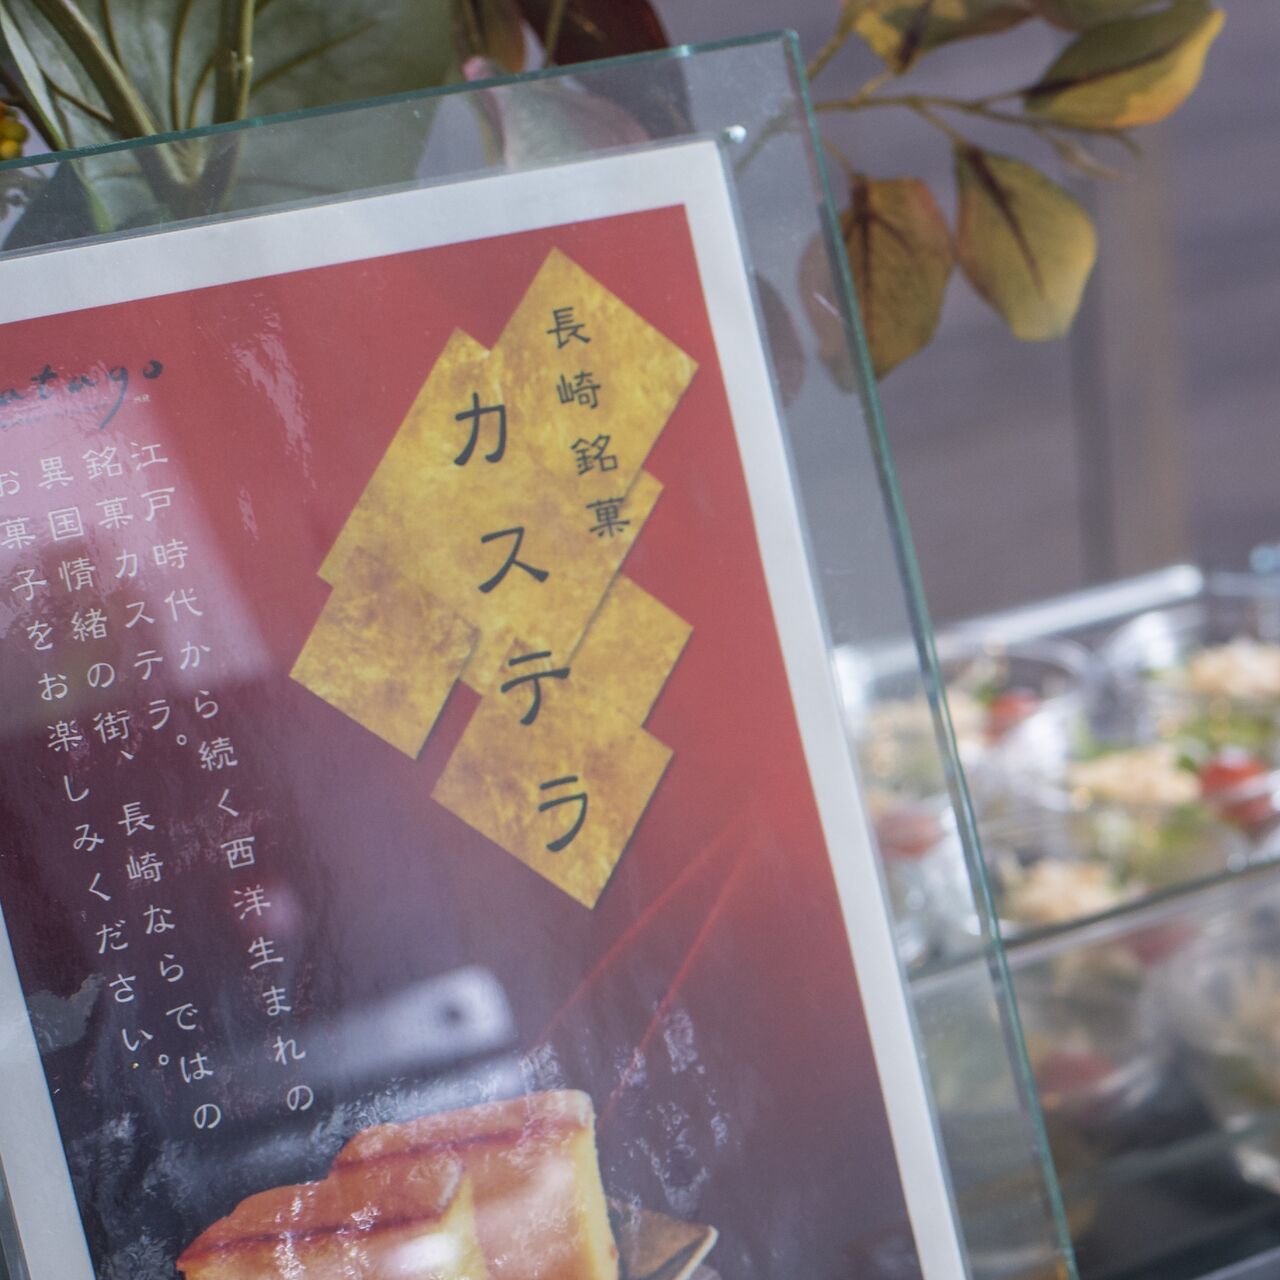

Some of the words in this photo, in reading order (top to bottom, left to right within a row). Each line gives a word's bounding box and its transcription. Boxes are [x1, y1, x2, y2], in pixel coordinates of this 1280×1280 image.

[82, 445, 187, 748] 銘菓カステラ。
[453, 391, 589, 853] カステラ
[547, 306, 631, 538] 長崎銘菓
[0, 470, 169, 1067] お菓子をお楽しみください。
[38, 456, 221, 1130] 異国情緒の街、長崎ならではの
[130, 441, 314, 1111] 江戸時代から続く西洋生まれの
